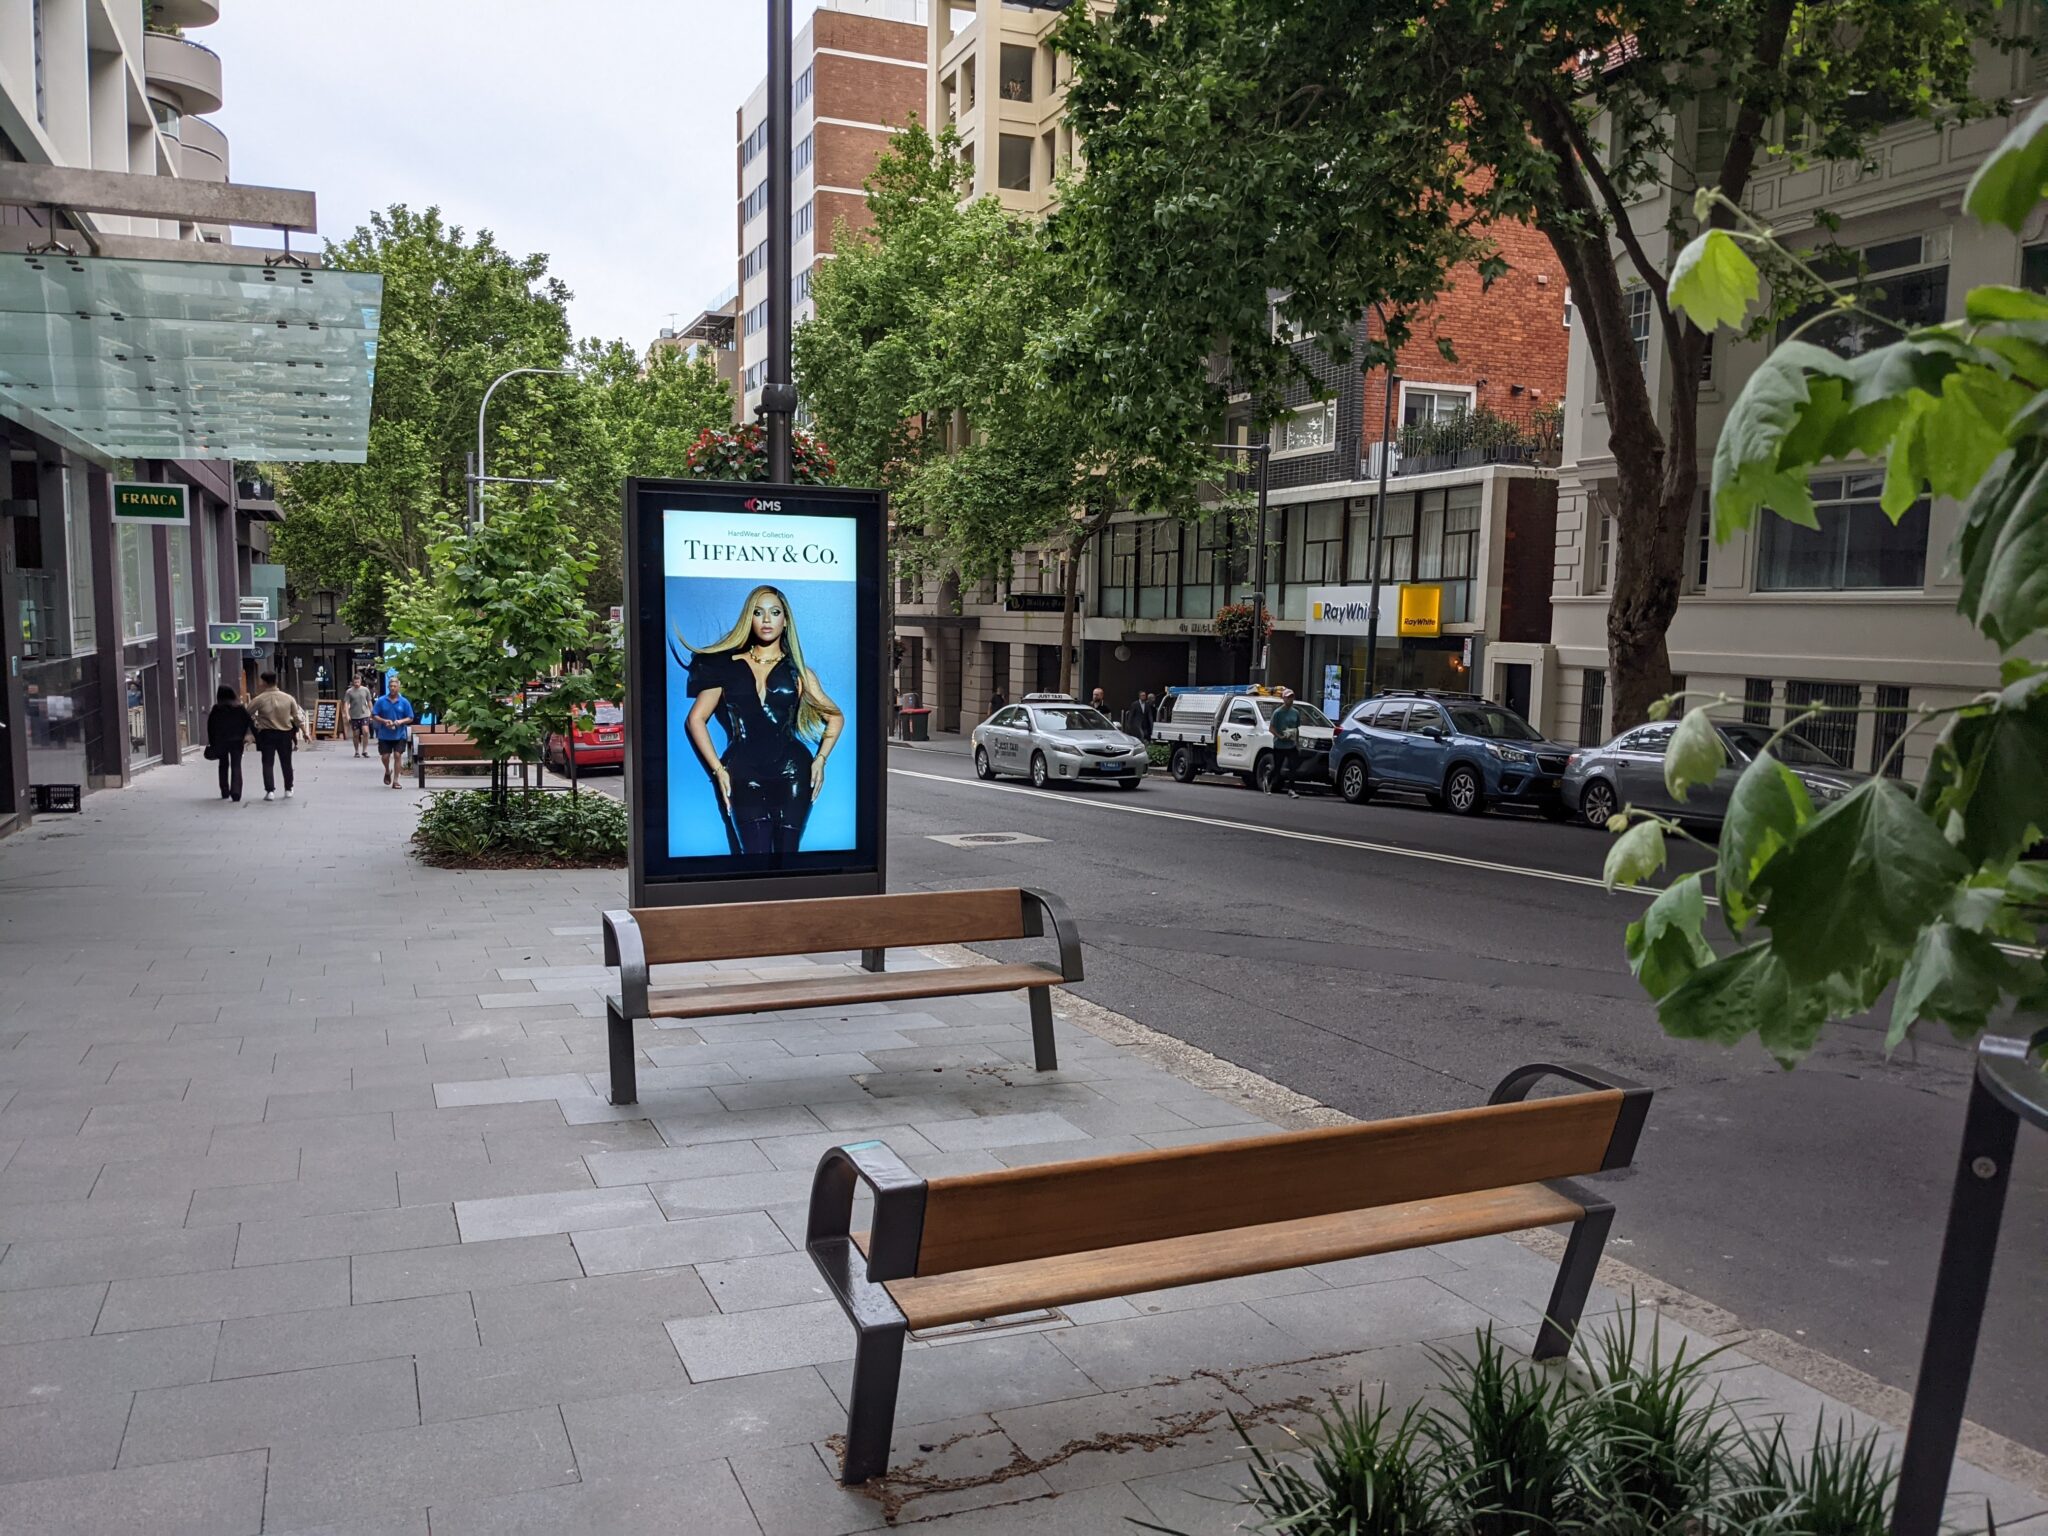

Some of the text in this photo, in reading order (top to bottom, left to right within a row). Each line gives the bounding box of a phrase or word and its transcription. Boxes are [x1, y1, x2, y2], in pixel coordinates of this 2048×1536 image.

[122, 493, 177, 506] FRANCA
[746, 497, 782, 512] QMS
[727, 529, 795, 540] HardWear Collection
[1323, 602, 1381, 625] RayWhi
[1404, 617, 1436, 627] RayWhite
